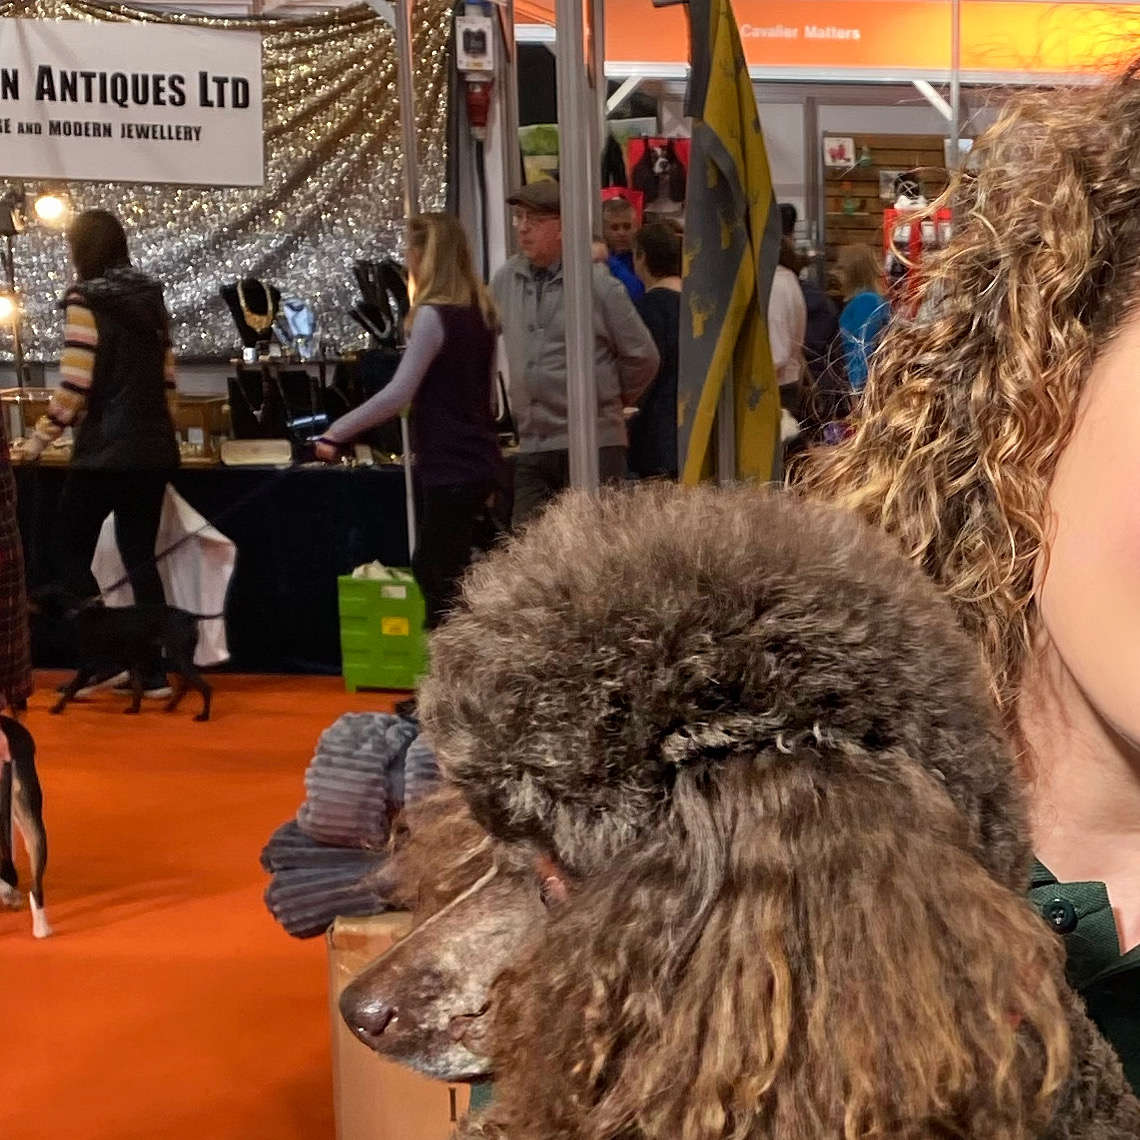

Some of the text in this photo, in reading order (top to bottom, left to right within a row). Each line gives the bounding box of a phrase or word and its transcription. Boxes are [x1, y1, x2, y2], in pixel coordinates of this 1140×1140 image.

[741, 24, 861, 39] Cavalier Matters
[35, 65, 186, 109] ANTIQUES
[199, 71, 250, 109] LTD
[17, 121, 42, 135] AND
[49, 120, 112, 138] MODERN
[120, 123, 202, 141] JEWELLERY
